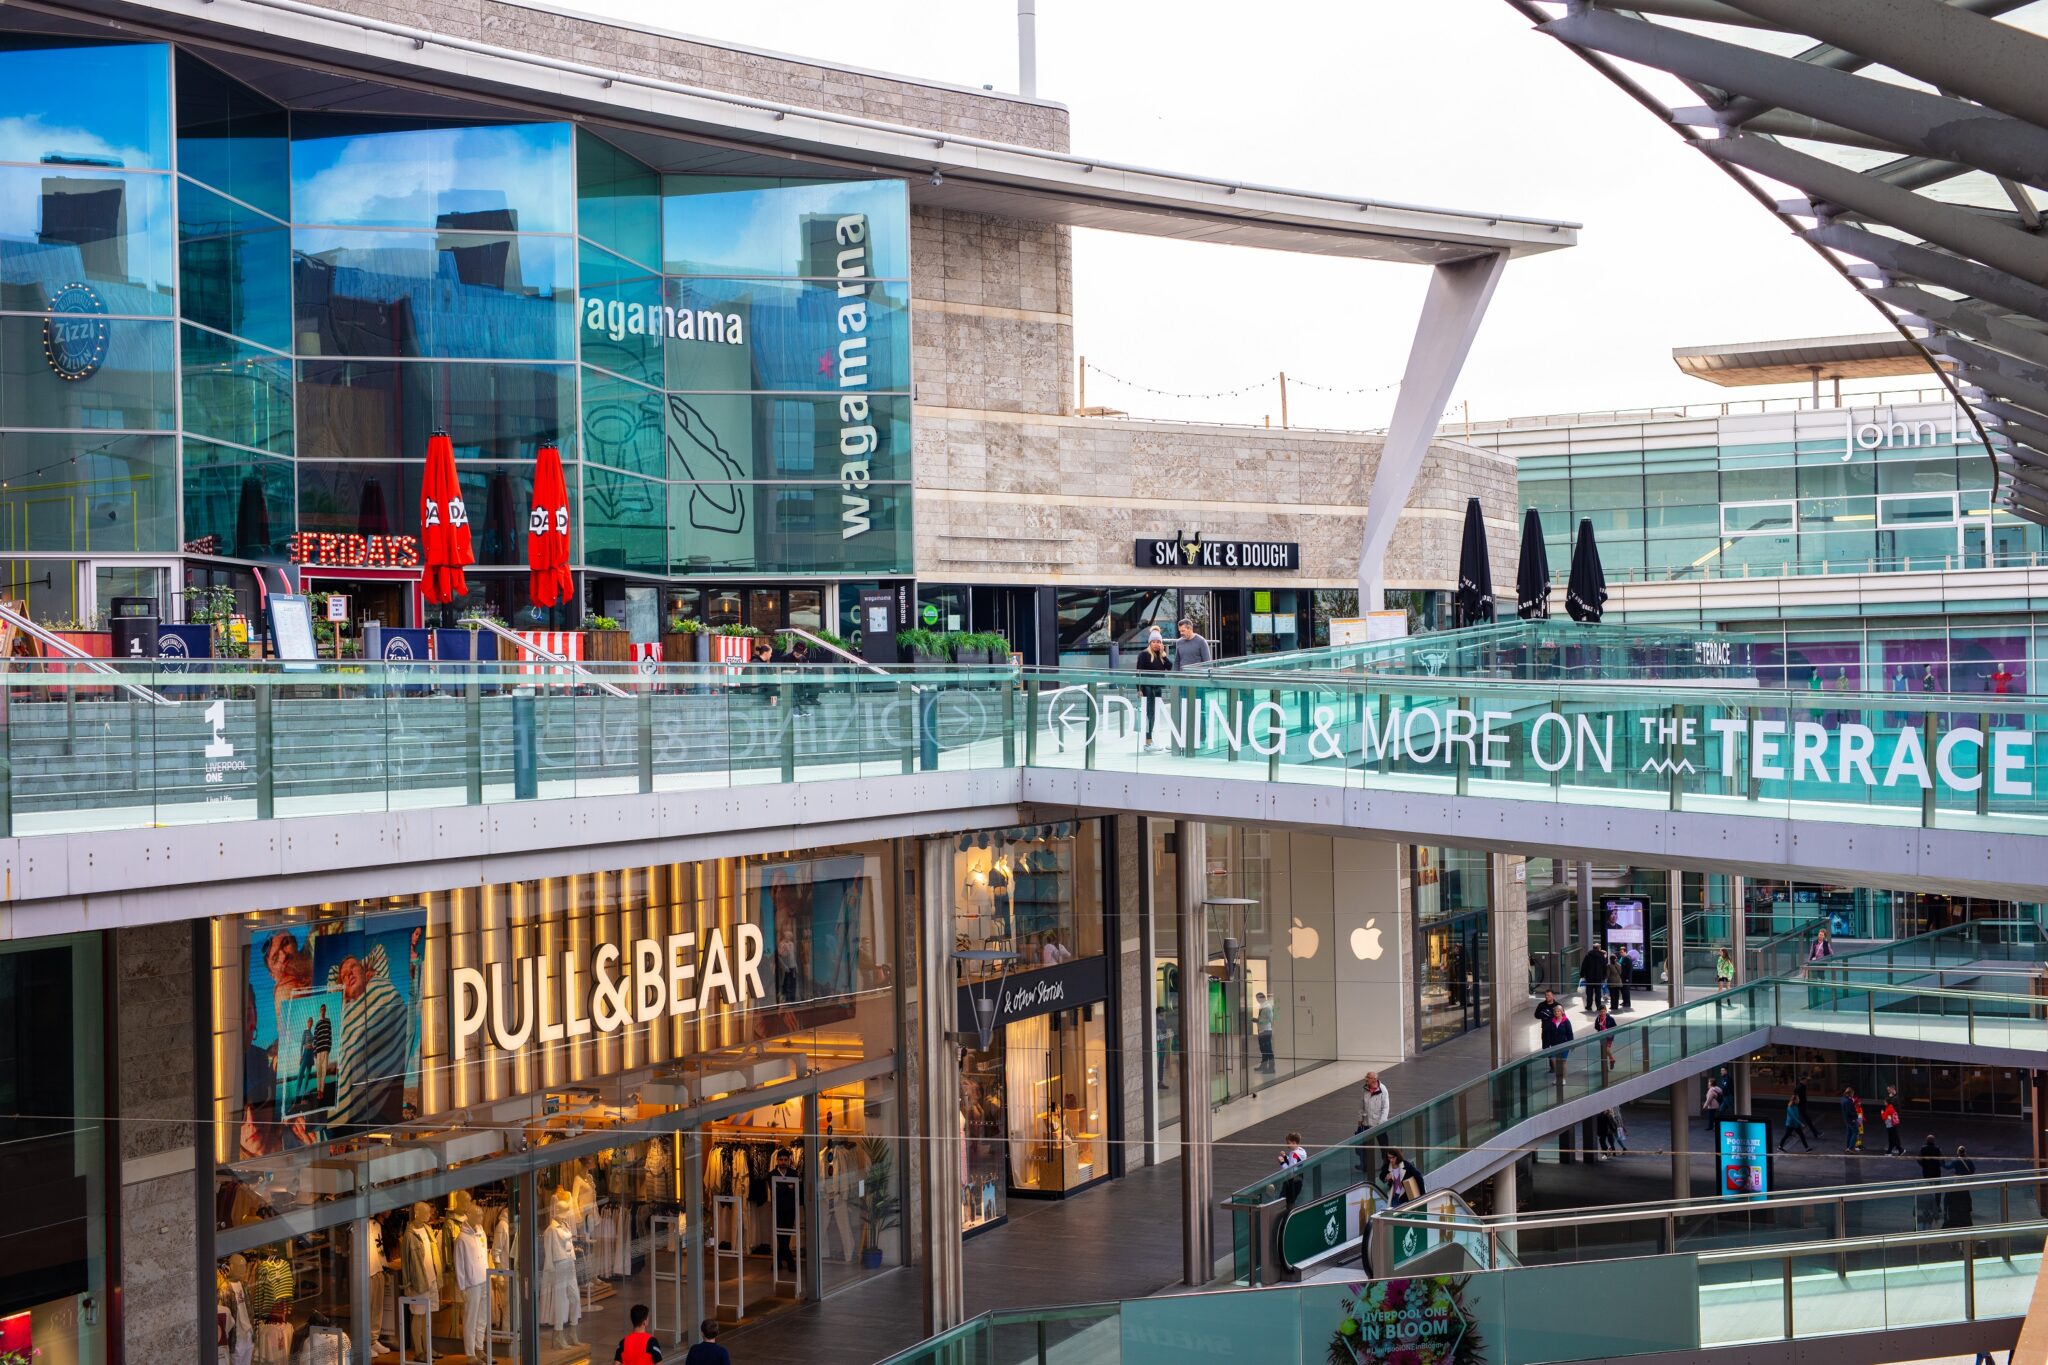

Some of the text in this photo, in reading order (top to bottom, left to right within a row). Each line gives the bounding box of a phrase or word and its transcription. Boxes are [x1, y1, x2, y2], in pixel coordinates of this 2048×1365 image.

[54, 318, 95, 344] Zizzi
[835, 212, 878, 540] wagamama
[1841, 411, 1937, 462] John
[302, 531, 420, 567] FRIDAYS
[1155, 541, 1288, 567] SMKE & DOUGH
[130, 637, 143, 653] 1
[1702, 642, 1731, 665] TERRACE
[204, 700, 234, 758] 1
[1102, 695, 2034, 796] DINING & MORE ON THE TERRACE
[205, 760, 248, 772] LIVERPOOL
[205, 772, 223, 783] ONE
[451, 922, 766, 1061] PULL&BEAR
[1003, 980, 1064, 1014] & other Stories
[1361, 1306, 1448, 1323] LIVERPOOL ONE
[1361, 1319, 1448, 1342] IN BLOOM
